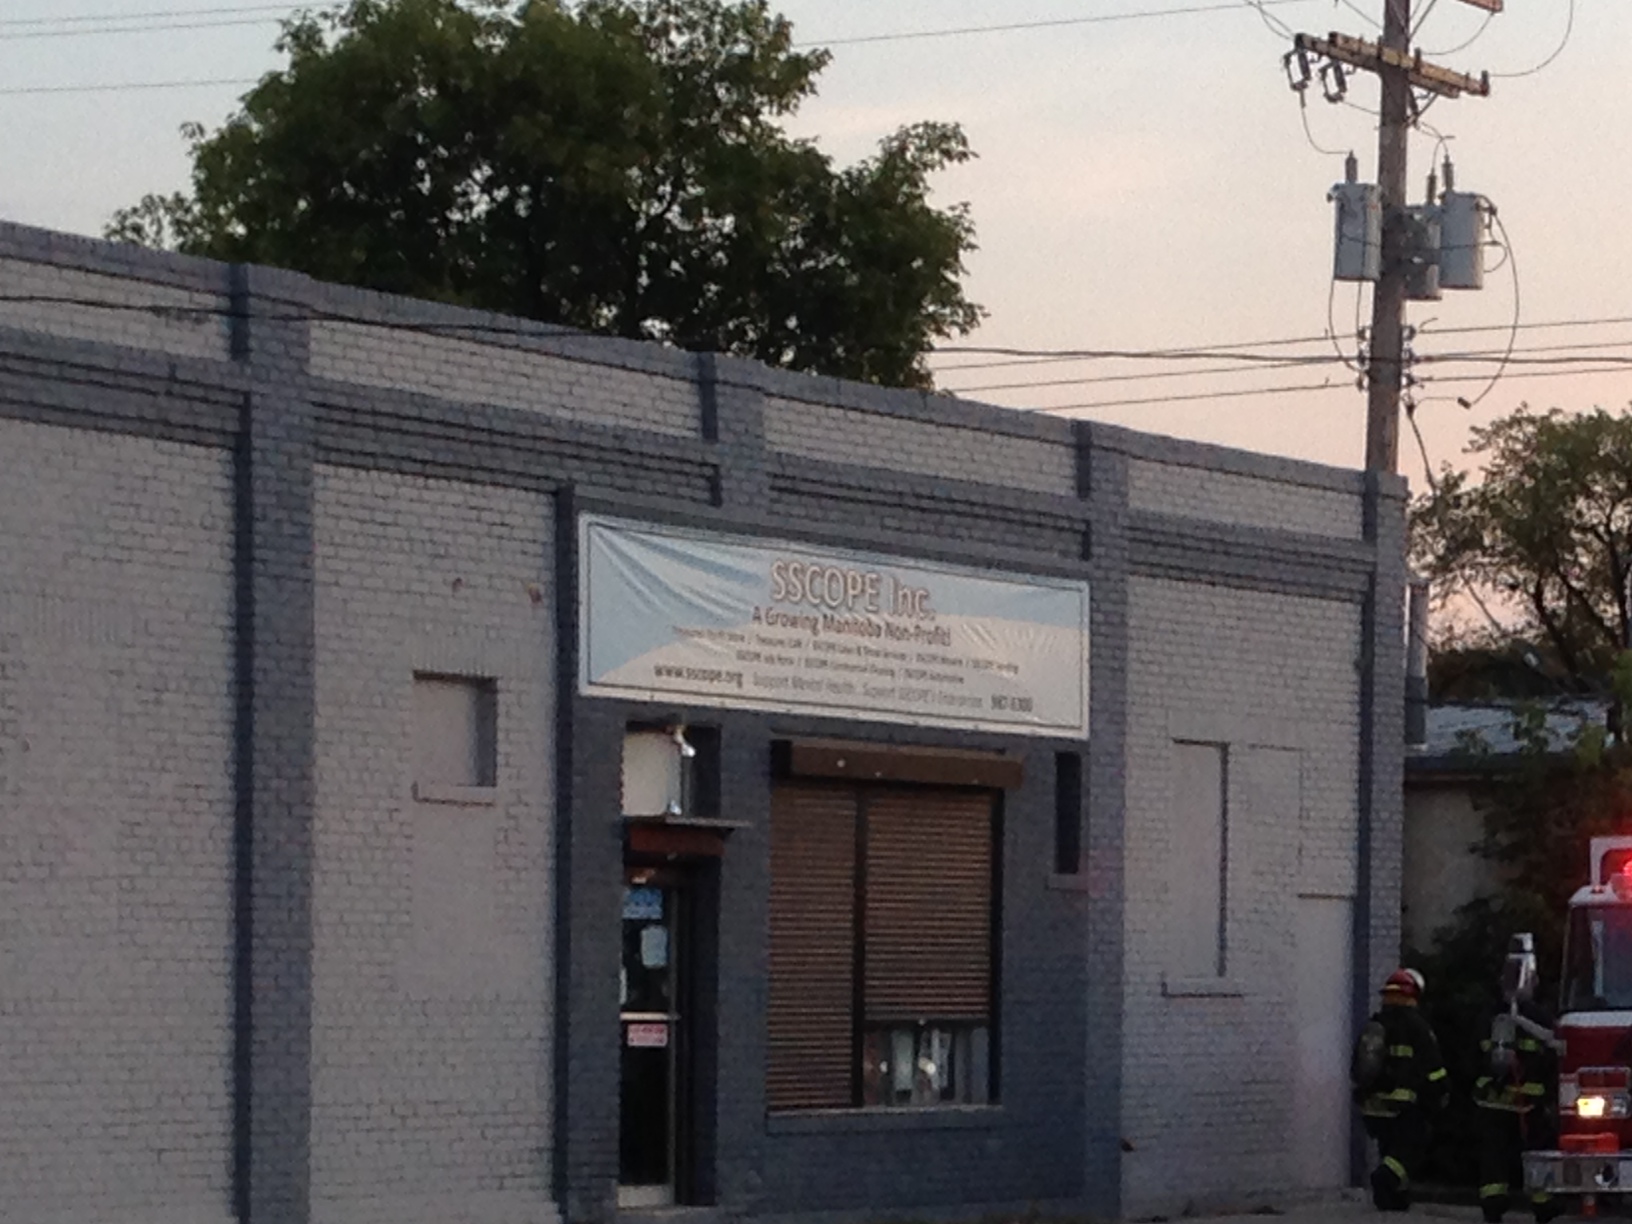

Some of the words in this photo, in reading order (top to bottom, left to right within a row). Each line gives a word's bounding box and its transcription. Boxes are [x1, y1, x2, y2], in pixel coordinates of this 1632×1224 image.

[771, 557, 883, 612] SSCOPE
[887, 575, 936, 621] Inc.
[752, 606, 762, 625] A
[765, 607, 820, 636] Growing
[822, 614, 883, 639] Manitoba
[653, 665, 744, 688] www.sscope.org
